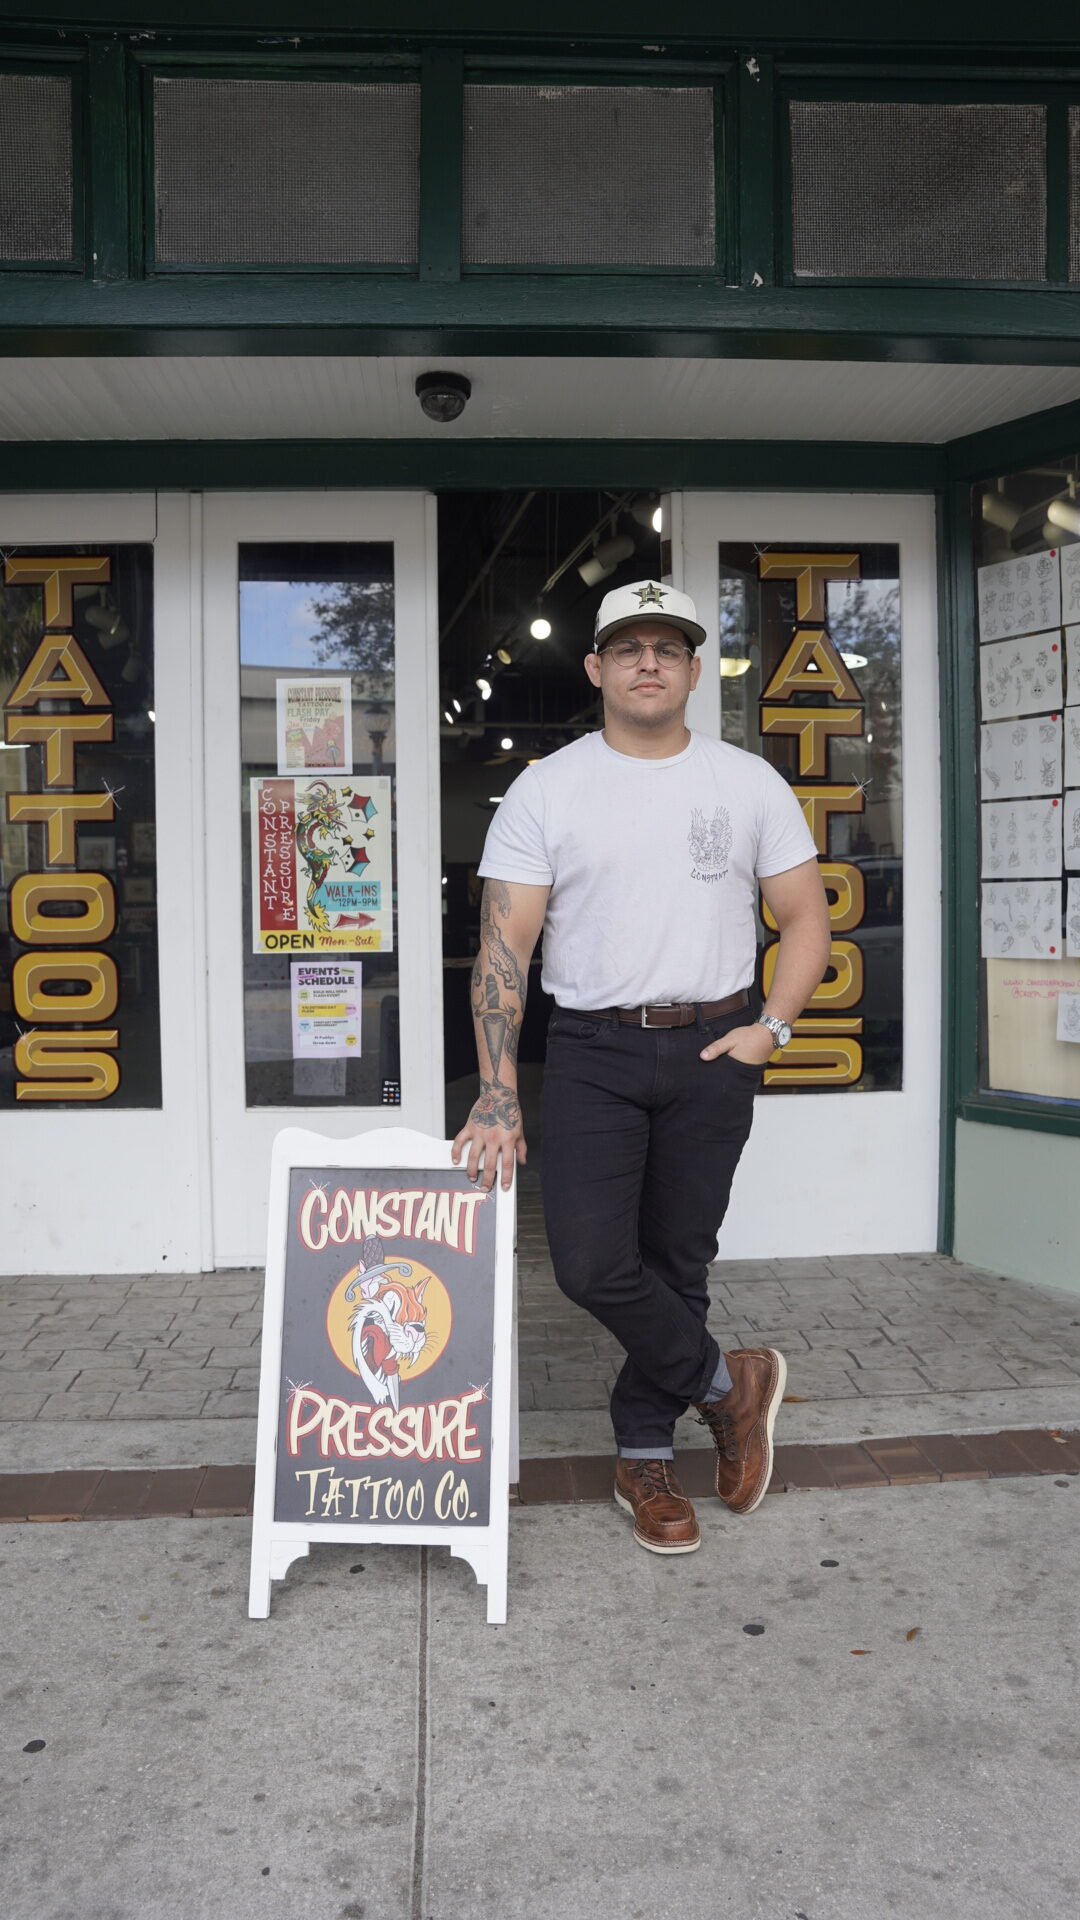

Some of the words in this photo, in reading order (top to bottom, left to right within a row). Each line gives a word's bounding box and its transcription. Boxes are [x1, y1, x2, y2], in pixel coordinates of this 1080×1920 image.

[287, 708, 312, 717] FLASH
[4, 556, 120, 1101] TATTOOS
[261, 788, 278, 910] CONSTANT
[279, 799, 296, 921] PRESSURE
[690, 868, 729, 885] CONSTANT
[324, 884, 378, 902] WALK-INS
[338, 897, 378, 907] 12PM-9PM
[265, 934, 315, 950] OPEN
[298, 967, 340, 976] EVENTS
[298, 976, 355, 986] SCHEDULE
[299, 1188, 488, 1253] CONSTANT
[287, 1387, 486, 1464] PRESSURE
[296, 1466, 426, 1521] TATTOO
[434, 1470, 478, 1520] CO.
